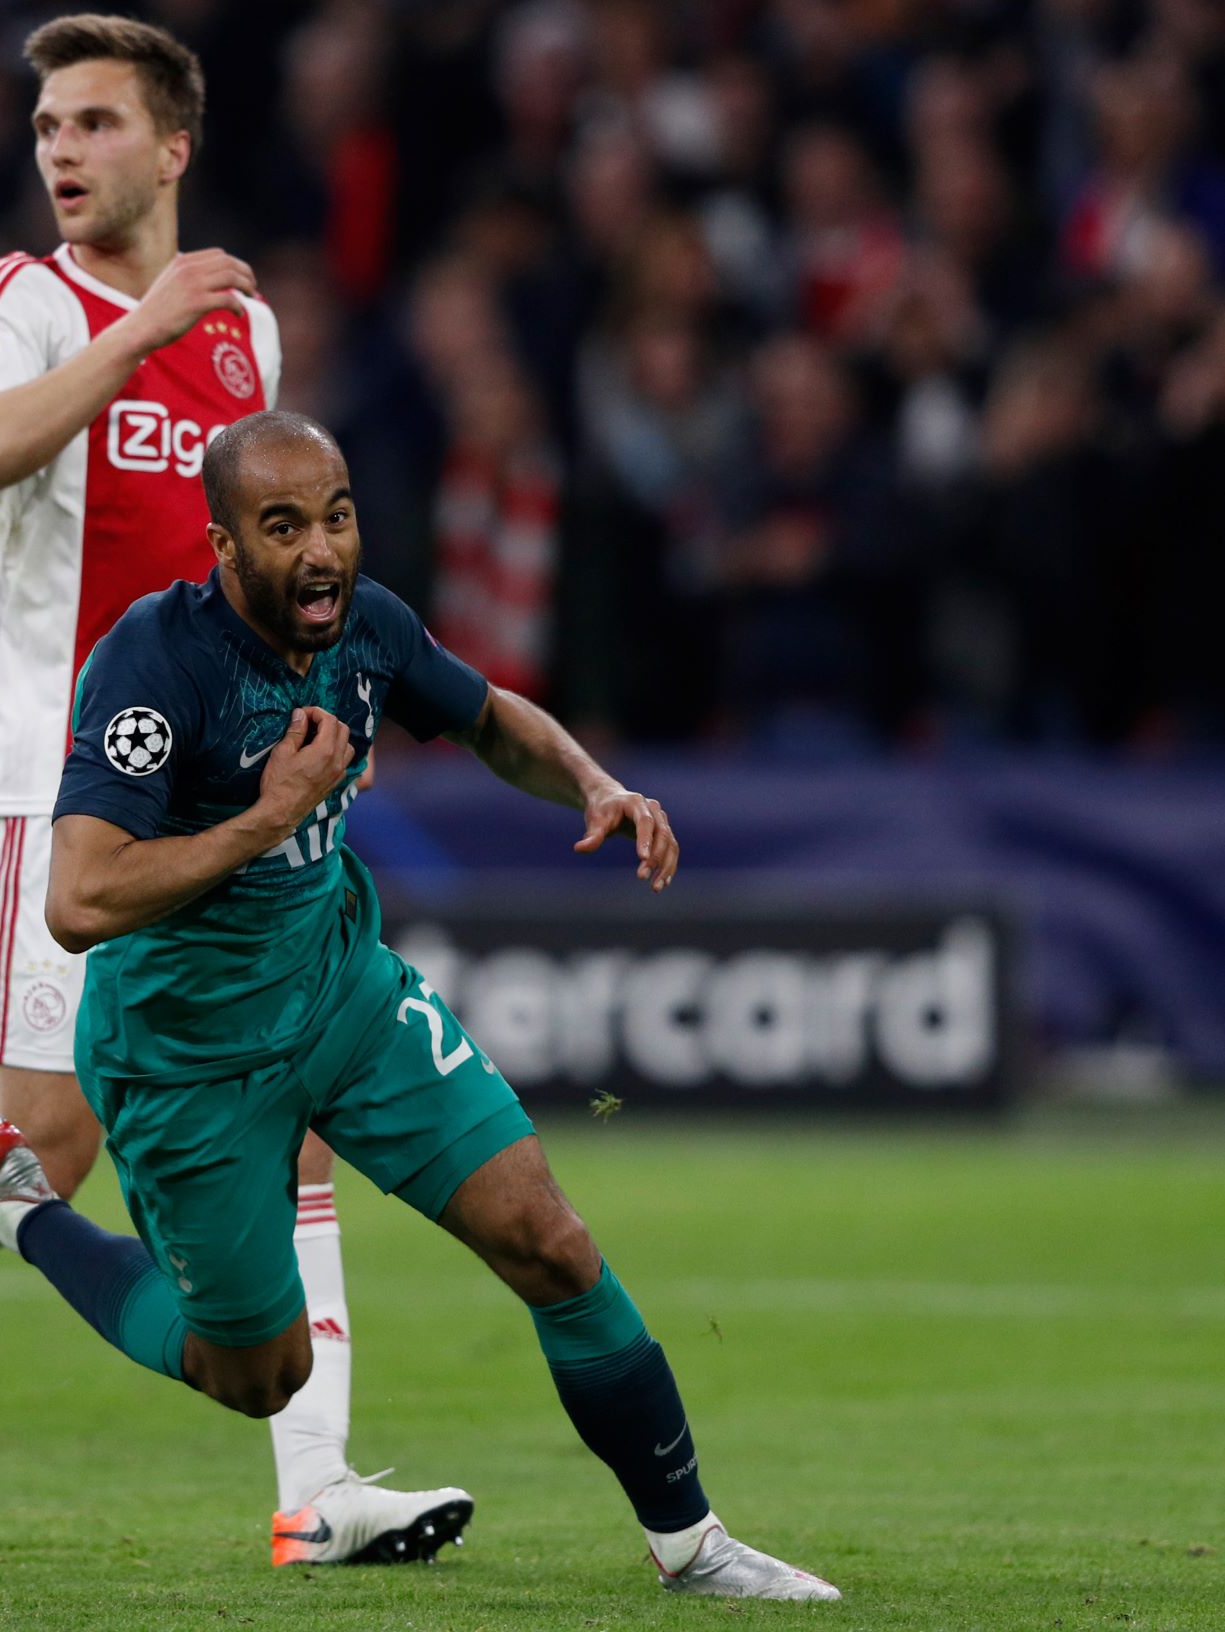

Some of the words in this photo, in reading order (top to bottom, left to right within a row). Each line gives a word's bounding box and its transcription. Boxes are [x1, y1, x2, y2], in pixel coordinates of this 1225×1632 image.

[117, 406, 228, 478] Zig
[396, 981, 474, 1076] 2
[666, 1456, 697, 1484] SPUR
